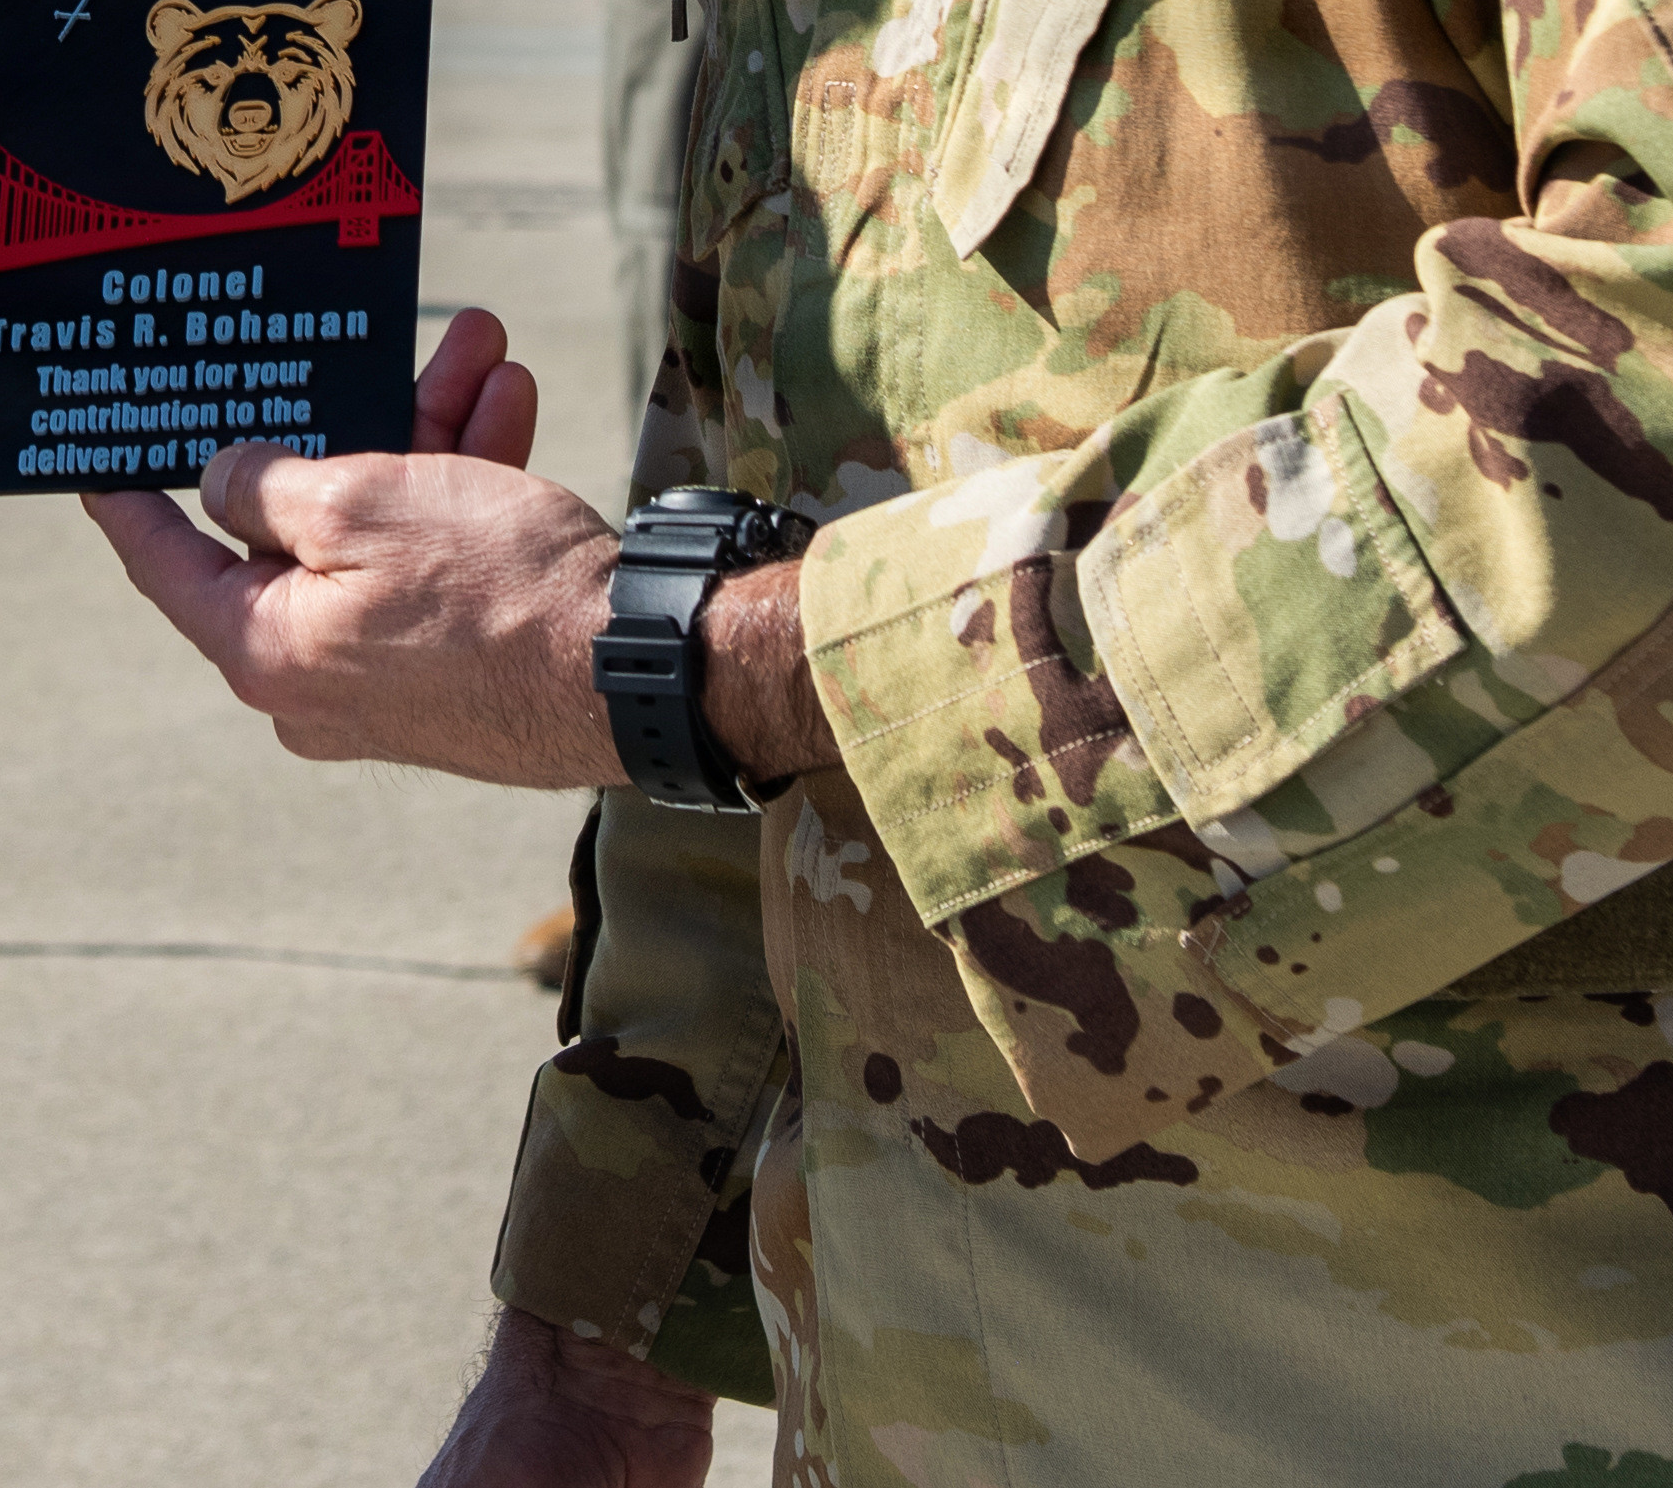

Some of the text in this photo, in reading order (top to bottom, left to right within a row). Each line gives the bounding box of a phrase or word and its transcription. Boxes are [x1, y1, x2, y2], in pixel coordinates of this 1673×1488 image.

[102, 265, 263, 304] Colonel
[133, 313, 167, 346] R.
[186, 309, 368, 344] Bohanan
[37, 360, 312, 396] Thank you for your
[31, 396, 311, 435] contribution to the
[18, 443, 142, 475] delivery
[148, 439, 178, 470] of
